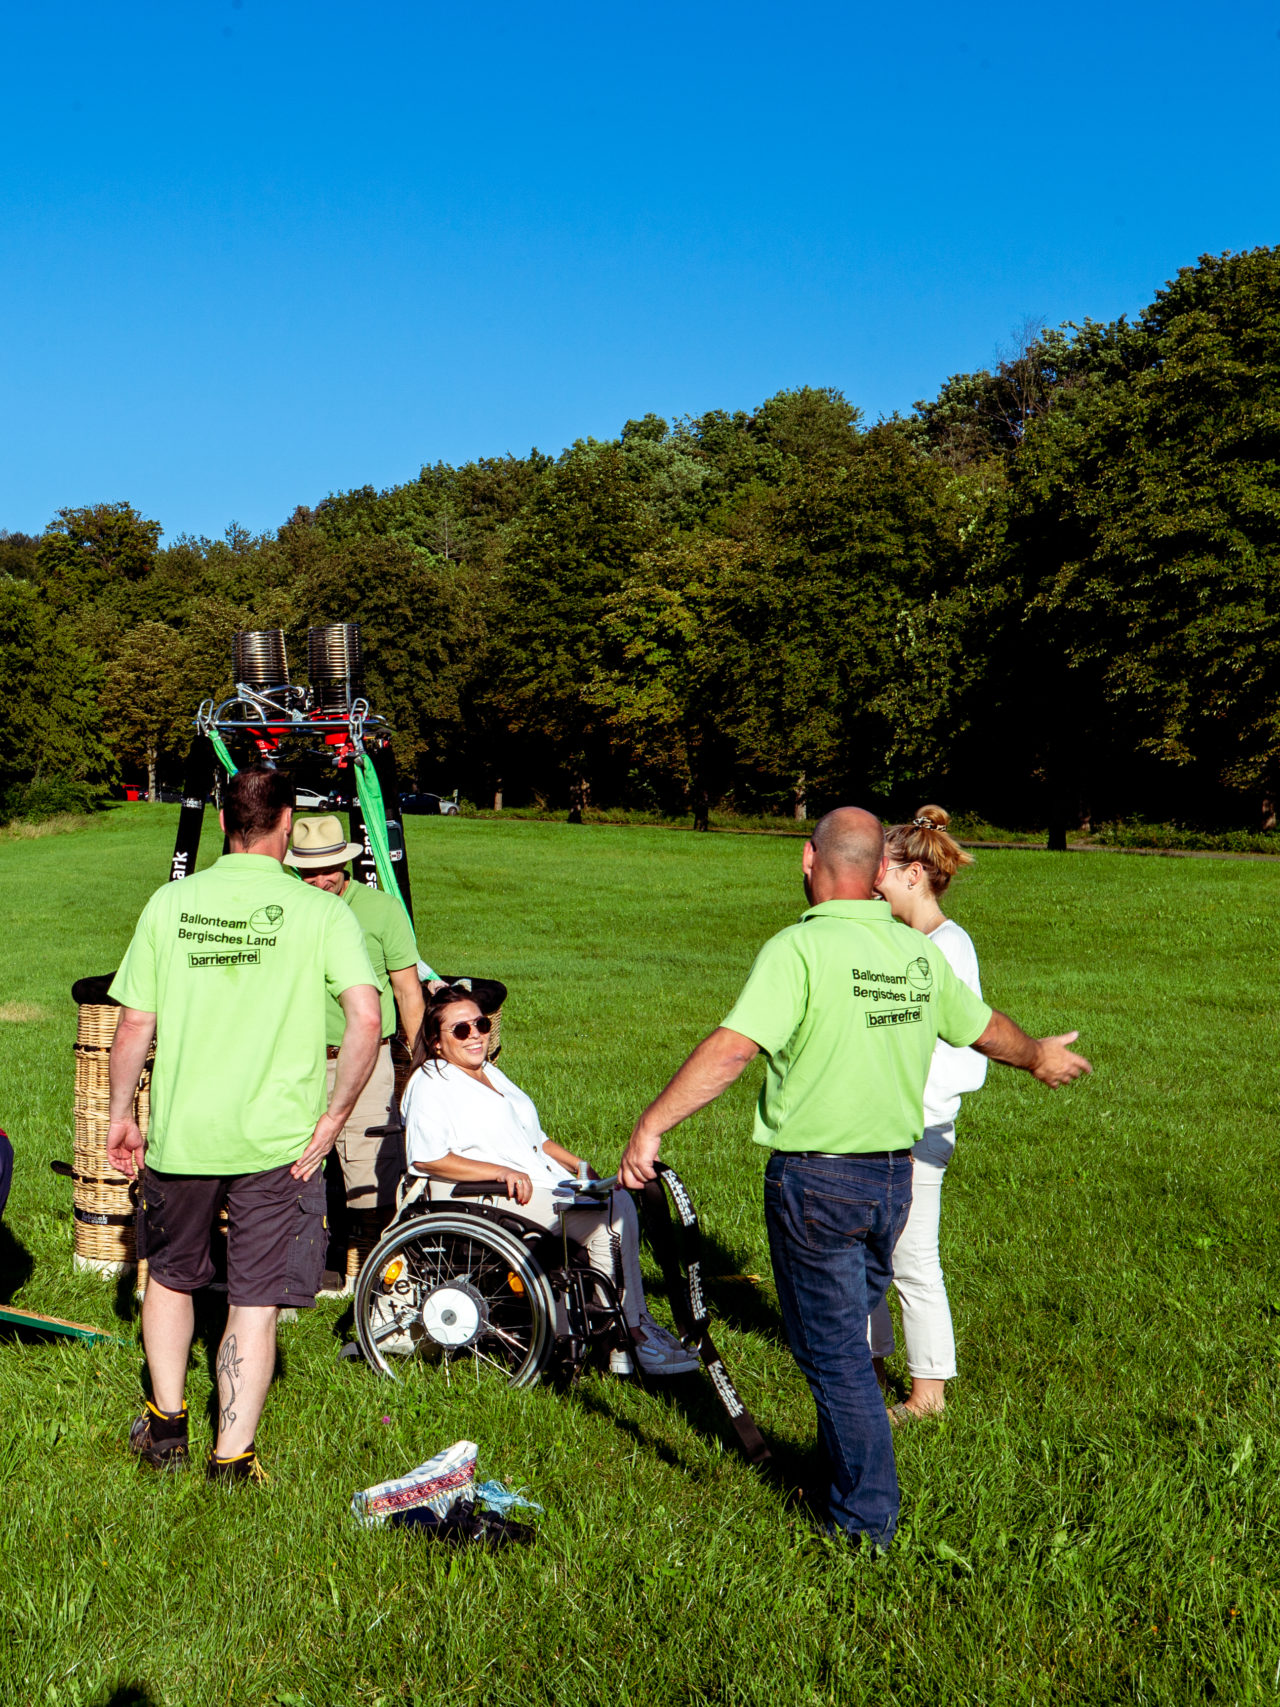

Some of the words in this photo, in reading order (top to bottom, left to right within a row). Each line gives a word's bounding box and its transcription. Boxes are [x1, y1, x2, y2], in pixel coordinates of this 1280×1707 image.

[172, 851, 189, 880] ark
[365, 871, 378, 890] es
[180, 912, 248, 929] Ballonteam
[178, 927, 243, 944] Bergisches
[246, 935, 277, 947] Land
[190, 951, 258, 966] barrierefrei
[852, 968, 907, 985] Ballonteam
[853, 985, 907, 1002] Bergisches
[909, 990, 931, 1003] Land
[868, 1008, 921, 1025] barrierefrei
